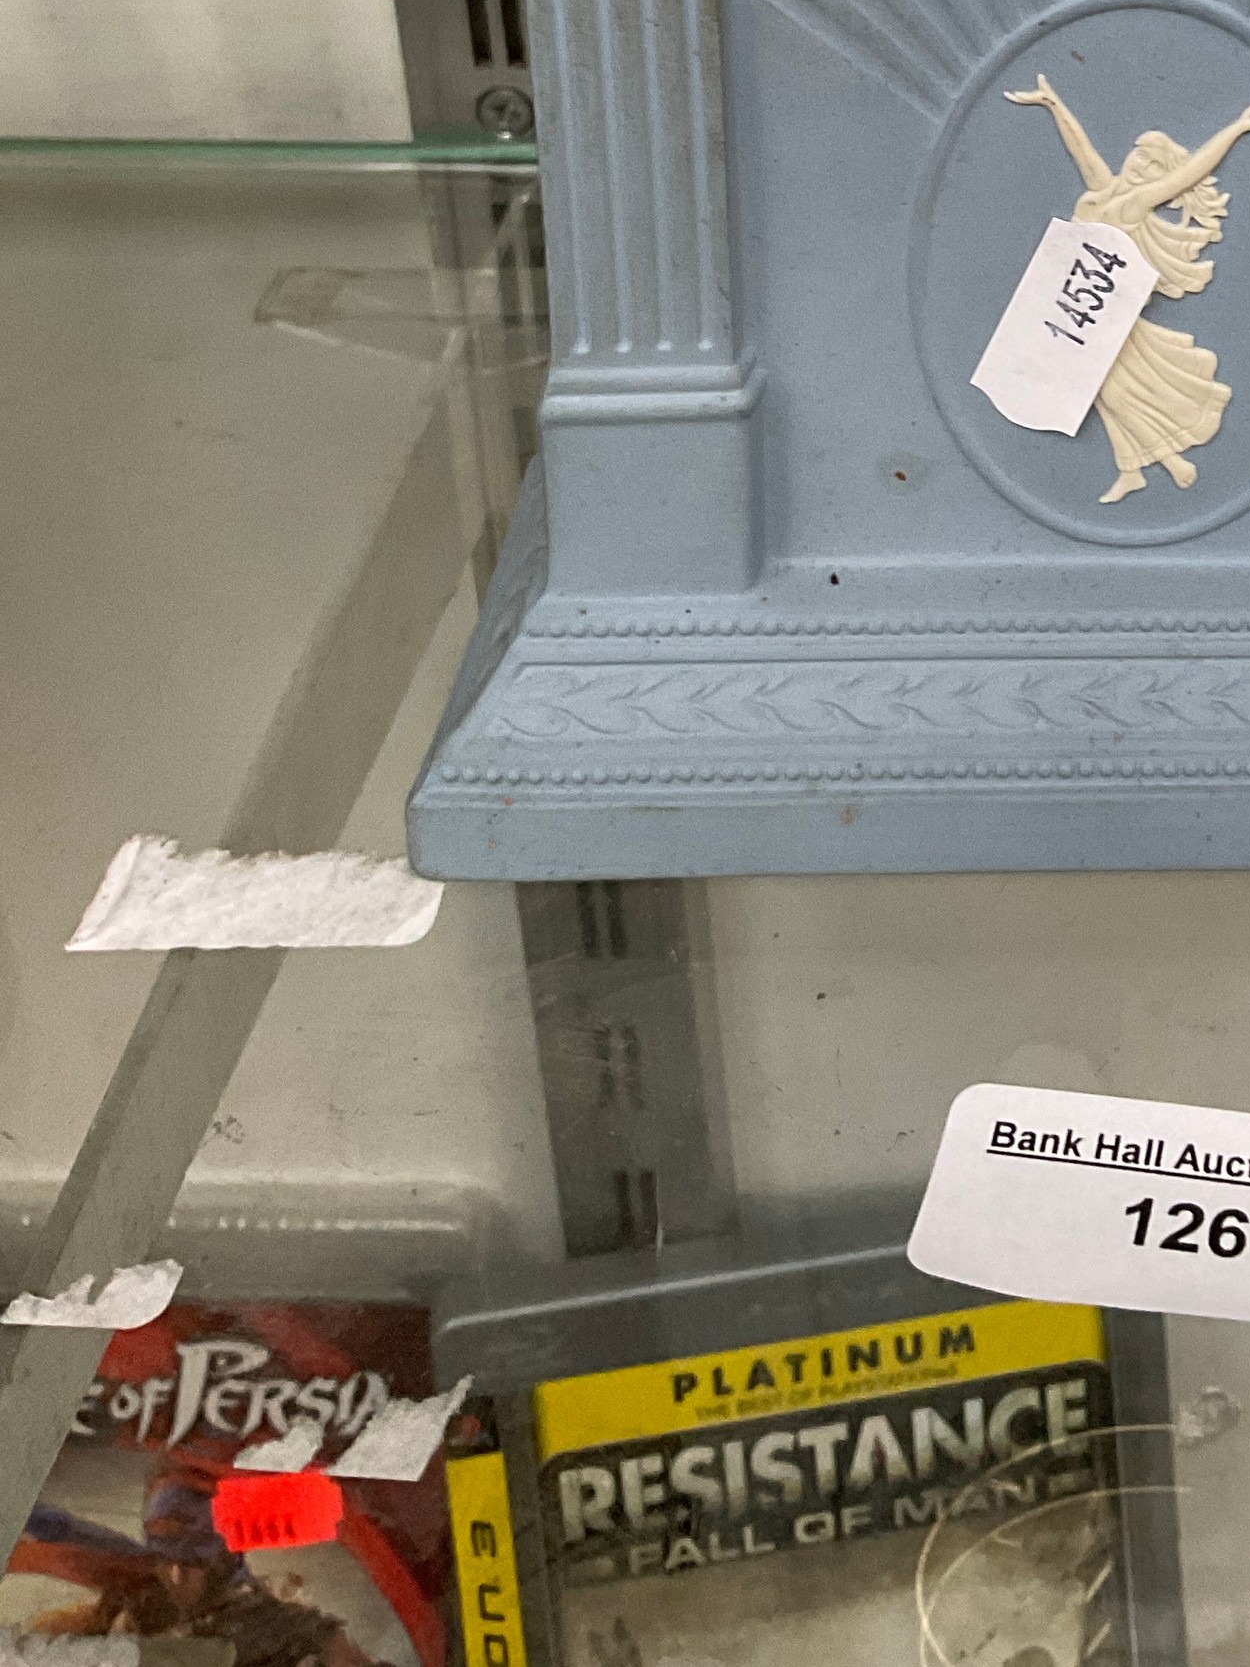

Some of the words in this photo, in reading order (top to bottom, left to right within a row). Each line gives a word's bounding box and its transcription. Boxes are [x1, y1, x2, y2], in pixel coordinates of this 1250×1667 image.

[1044, 242, 1128, 346] 14534
[991, 1120, 1083, 1159] Bank
[1094, 1133, 1164, 1168] Hall
[1125, 1197, 1250, 1259] 126
[670, 1323, 977, 1404] PLATINUM
[557, 1378, 1090, 1543] RESISTANCE
[630, 1524, 777, 1573] FALL
[793, 1504, 874, 1544] OF
[894, 1473, 1035, 1528] MAN
